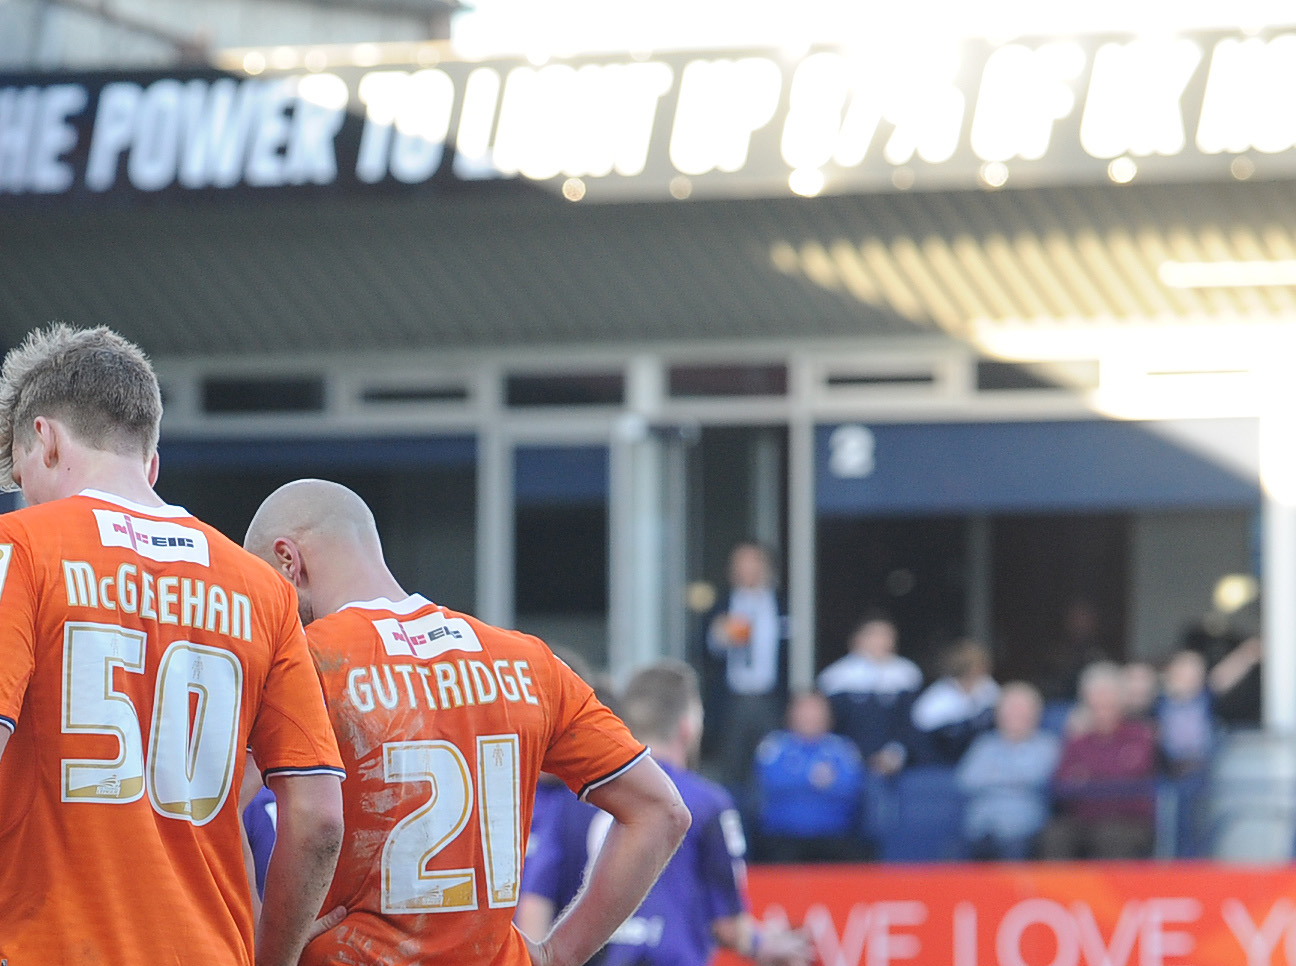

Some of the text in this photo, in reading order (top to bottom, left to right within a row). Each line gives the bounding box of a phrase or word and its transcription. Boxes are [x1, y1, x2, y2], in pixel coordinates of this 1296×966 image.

[83, 74, 350, 194] POWER
[355, 68, 456, 184] TO
[60, 620, 244, 827] 50
[347, 658, 540, 713] GUTTRIDGE
[380, 733, 522, 915] 21
